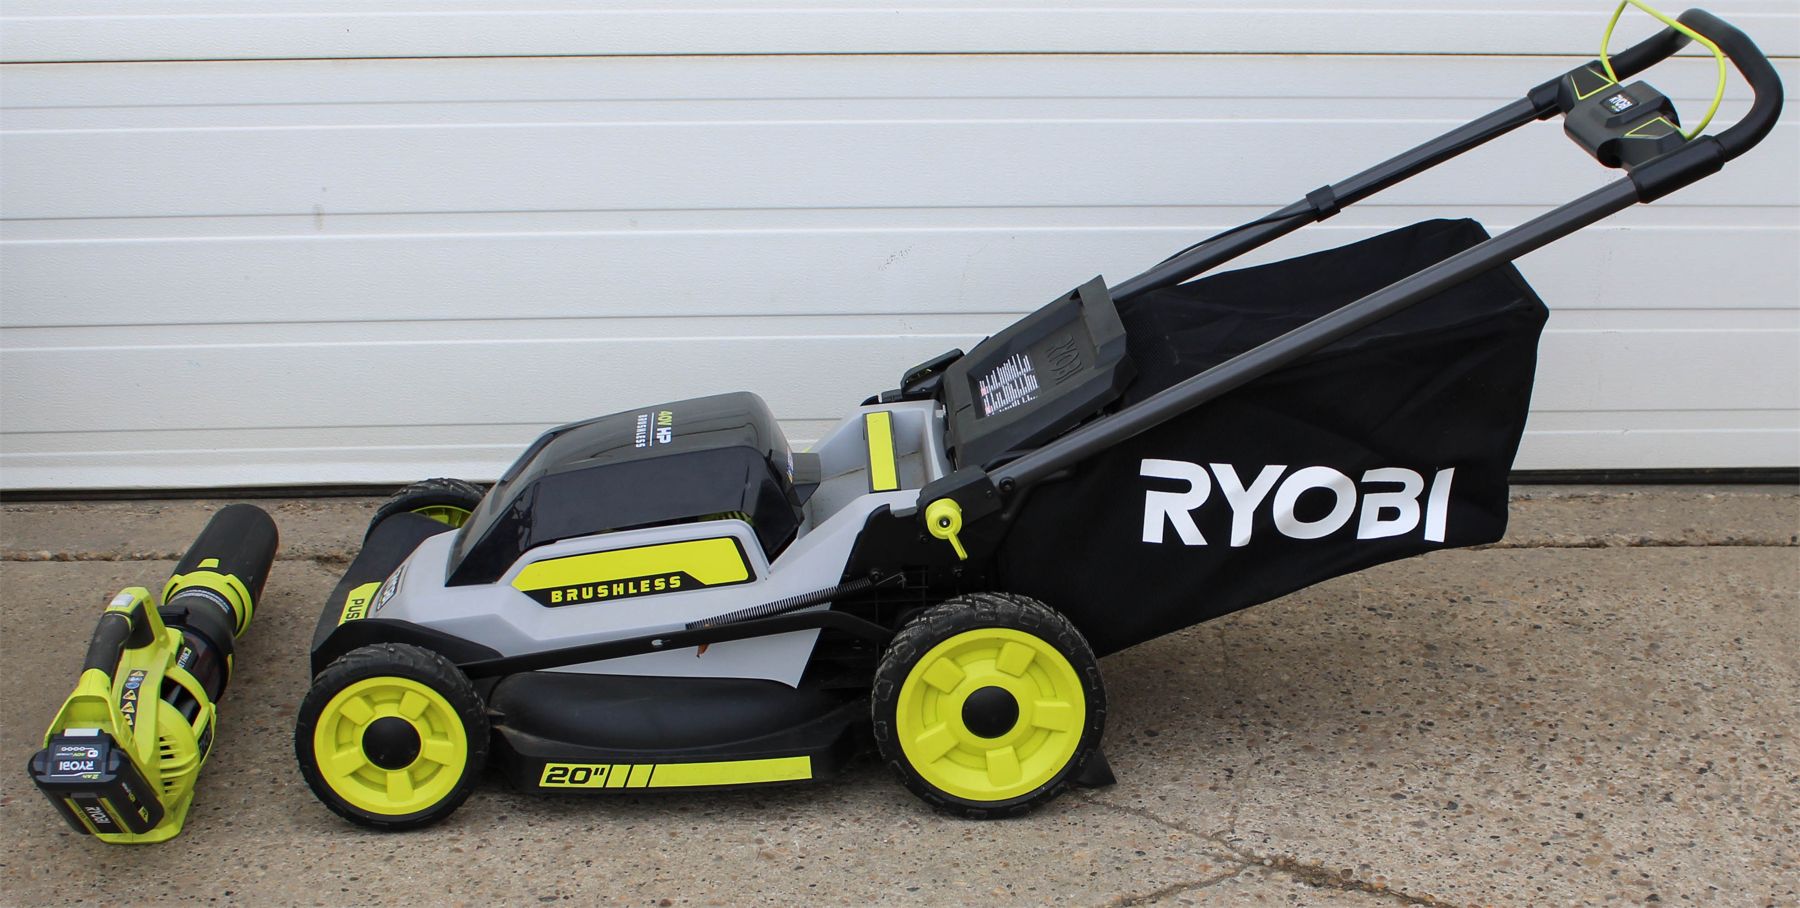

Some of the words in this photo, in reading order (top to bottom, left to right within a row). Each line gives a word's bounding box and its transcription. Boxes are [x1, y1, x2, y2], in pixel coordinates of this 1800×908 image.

[657, 410, 673, 426] 40V
[635, 414, 648, 448] BRUSHLESS
[656, 426, 672, 444] HP
[1140, 458, 1456, 547] RYOBI
[551, 575, 682, 603] BRUSHLESS
[345, 598, 365, 621] PUS
[59, 760, 94, 771] RYOBI
[545, 766, 606, 784] 20"
